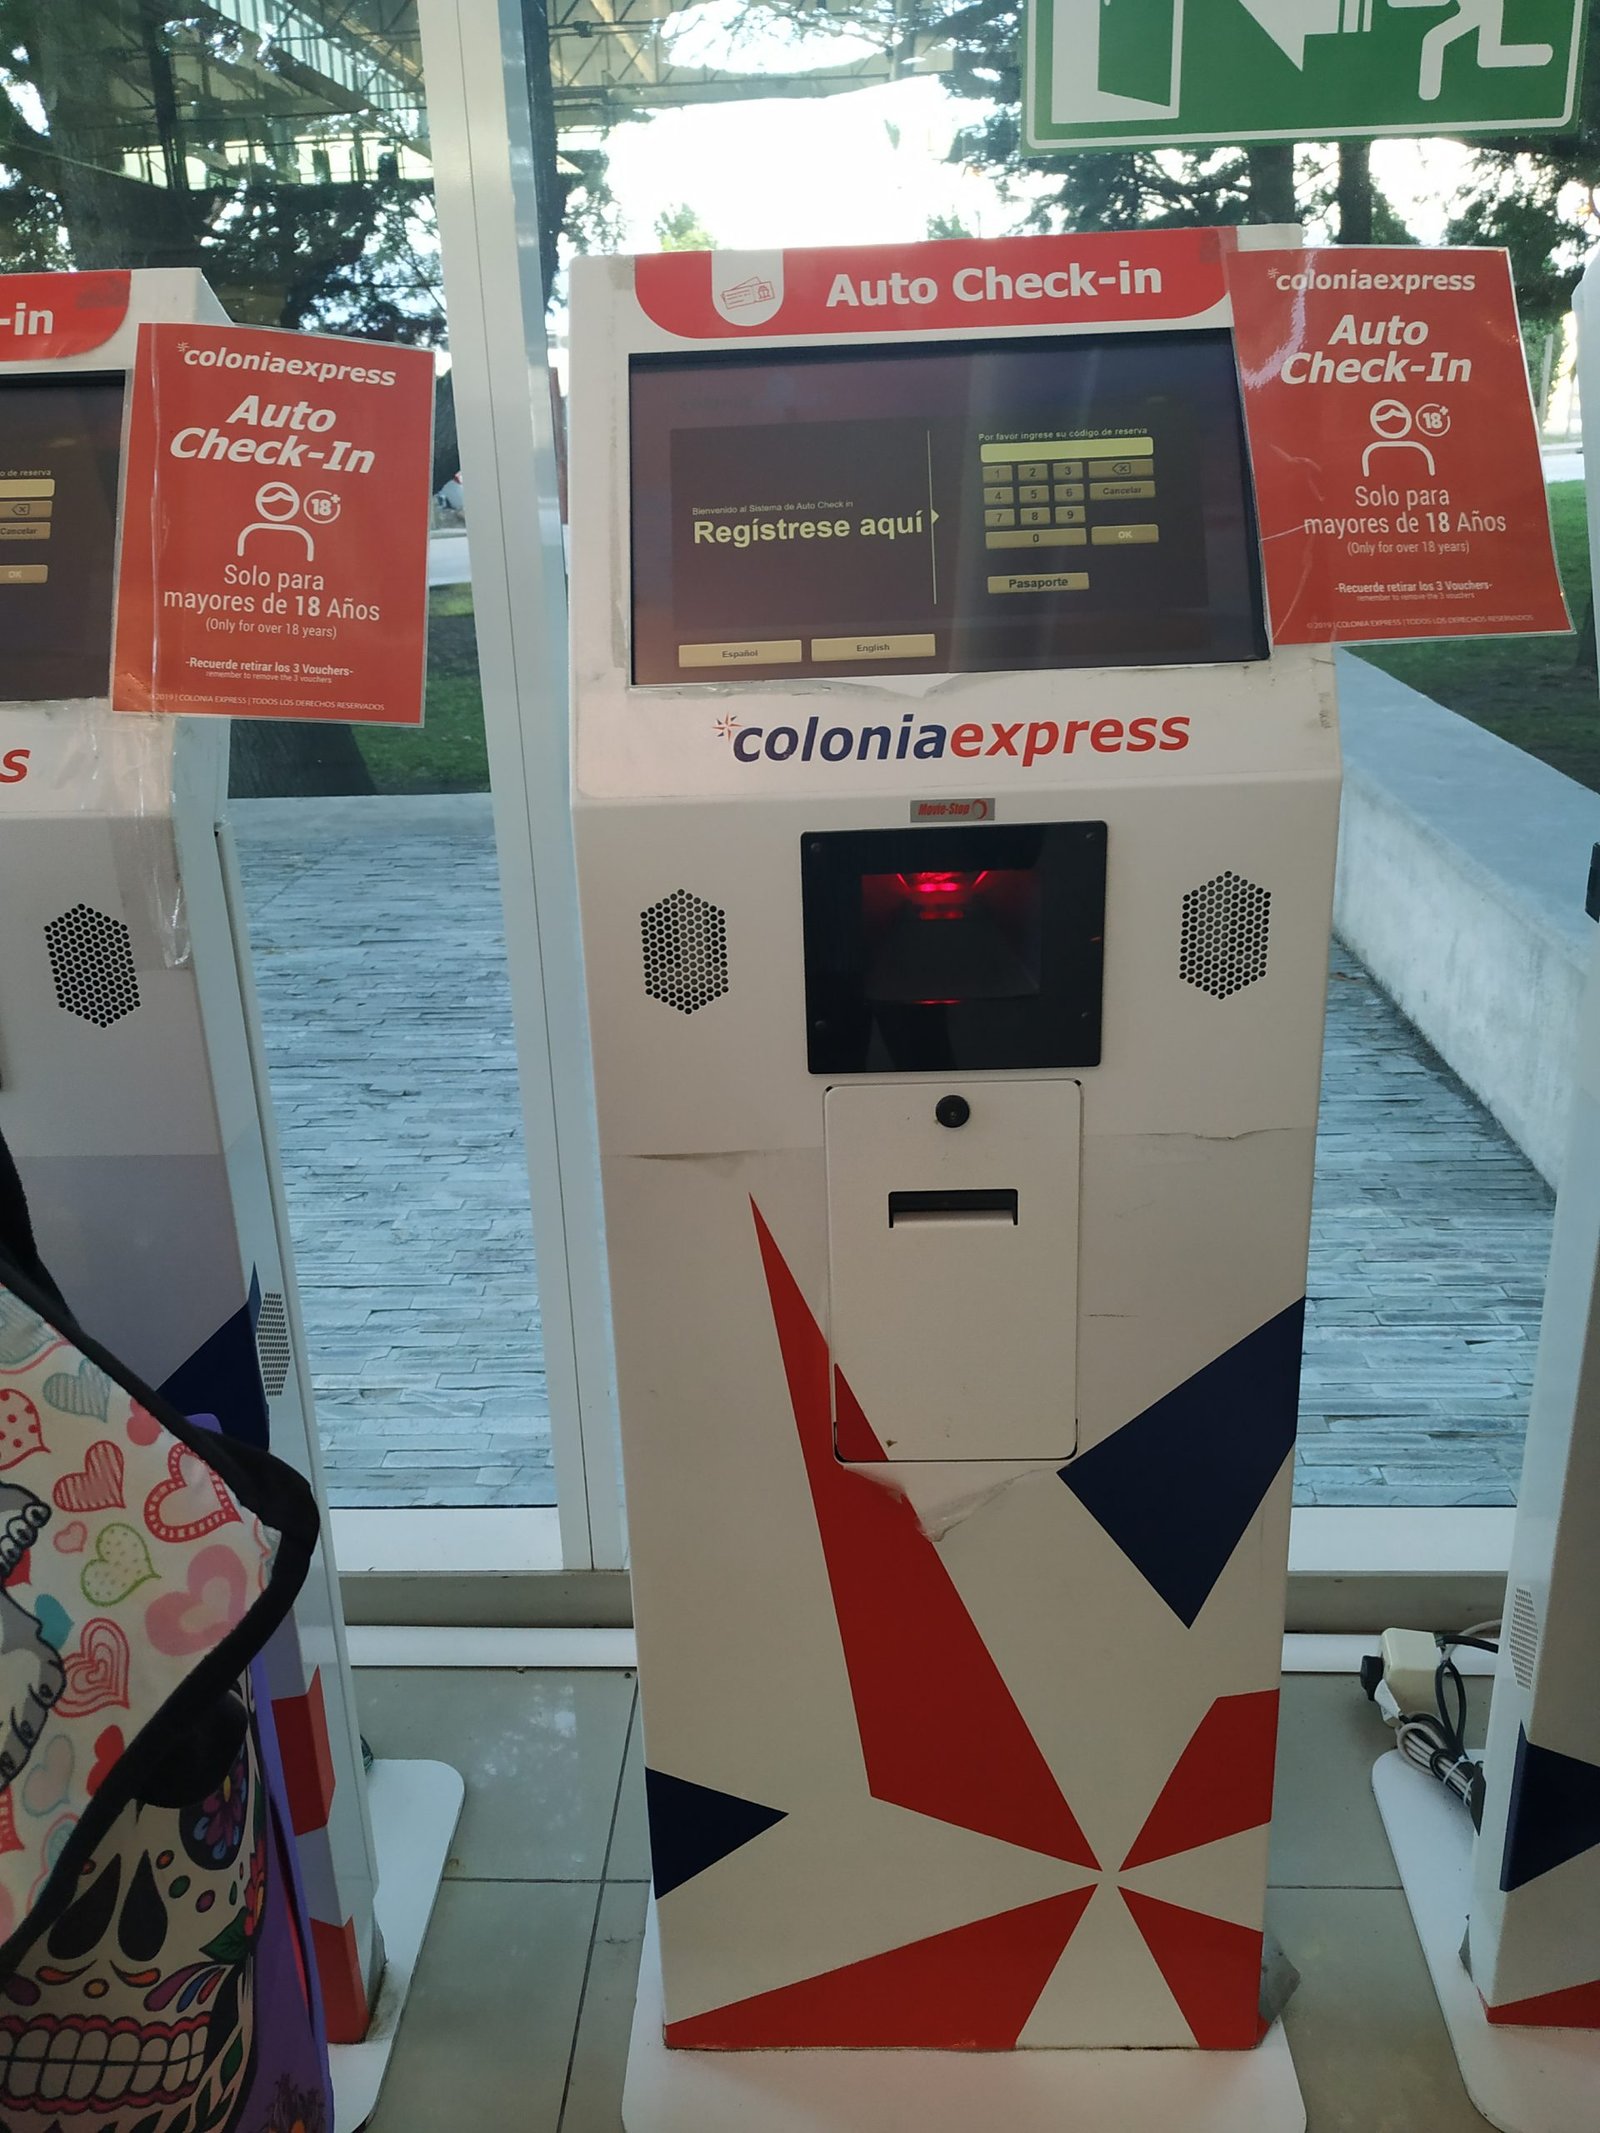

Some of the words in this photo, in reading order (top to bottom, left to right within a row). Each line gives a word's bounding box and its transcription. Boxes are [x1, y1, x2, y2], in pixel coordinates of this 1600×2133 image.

[826, 272, 938, 308] Auto
[952, 261, 1162, 301] Check-in
[1276, 268, 1476, 295] coloniaexpress
[1328, 314, 1429, 346] Auto
[183, 347, 397, 386] coloniaexpress
[1280, 351, 1472, 384] Check-In
[226, 395, 337, 432] Auto
[978, 433, 994, 442] Por
[996, 432, 1018, 441] favor
[1021, 431, 1053, 442] ingrese
[1056, 431, 1067, 439] su
[1102, 428, 1112, 437] de
[1114, 428, 1148, 436] reserva
[170, 427, 376, 474] Check-In
[994, 470, 1000, 478] 1
[1029, 468, 1036, 478] 2
[1065, 466, 1072, 476] 3
[994, 491, 1002, 500] 4
[1031, 490, 1037, 499] 5
[1066, 488, 1073, 497] 6
[1103, 486, 1142, 495] Cancelar
[1354, 484, 1400, 507] Solo
[1406, 488, 1450, 511] para
[692, 506, 738, 516] Bienvenido
[739, 505, 747, 513] al
[749, 504, 782, 513] Sistema
[784, 503, 795, 511] de
[796, 502, 815, 511] Auto
[817, 501, 844, 509] Check
[996, 513, 1002, 522] 7
[1031, 512, 1038, 521] 8
[1067, 510, 1074, 519] 9
[694, 518, 850, 548] Regístrese
[860, 510, 923, 540] aquí
[1304, 516, 1390, 540] mayores
[1395, 511, 1420, 534] de
[1425, 512, 1450, 534] 18
[1457, 510, 1507, 533] Años
[1033, 534, 1039, 543] 0
[1118, 530, 1132, 539] OK
[1347, 541, 1375, 557] (Only
[1378, 541, 1394, 554] for
[1396, 543, 1419, 554] over
[1422, 541, 1437, 553] 18
[1438, 540, 1470, 555] years)
[8, 570, 22, 578] OK
[223, 564, 271, 587] Solo
[277, 573, 325, 593] para
[1008, 578, 1068, 590] Pasaporte
[1387, 581, 1417, 592] retirar
[1419, 580, 1434, 592] los
[1436, 580, 1443, 591] 3
[163, 590, 255, 615] mayores
[262, 592, 288, 615] de
[295, 595, 321, 617] 18
[327, 597, 381, 621] Años
[206, 618, 236, 634] (Only
[238, 618, 254, 632] for
[257, 623, 282, 634] over
[286, 623, 299, 636] 18
[302, 626, 338, 640] years)
[722, 649, 759, 659] Español
[856, 643, 890, 653] English
[240, 660, 272, 672] retirar
[275, 661, 290, 673] los
[293, 663, 300, 673] 3
[179, 694, 213, 703] COLONIA
[215, 695, 247, 704] EXPRESS
[252, 697, 279, 705] TODOS
[280, 698, 294, 706] LOS
[295, 699, 336, 709] DERECHOS
[336, 701, 385, 711] RESERVADOS
[733, 714, 1191, 768] coloniaexpress
